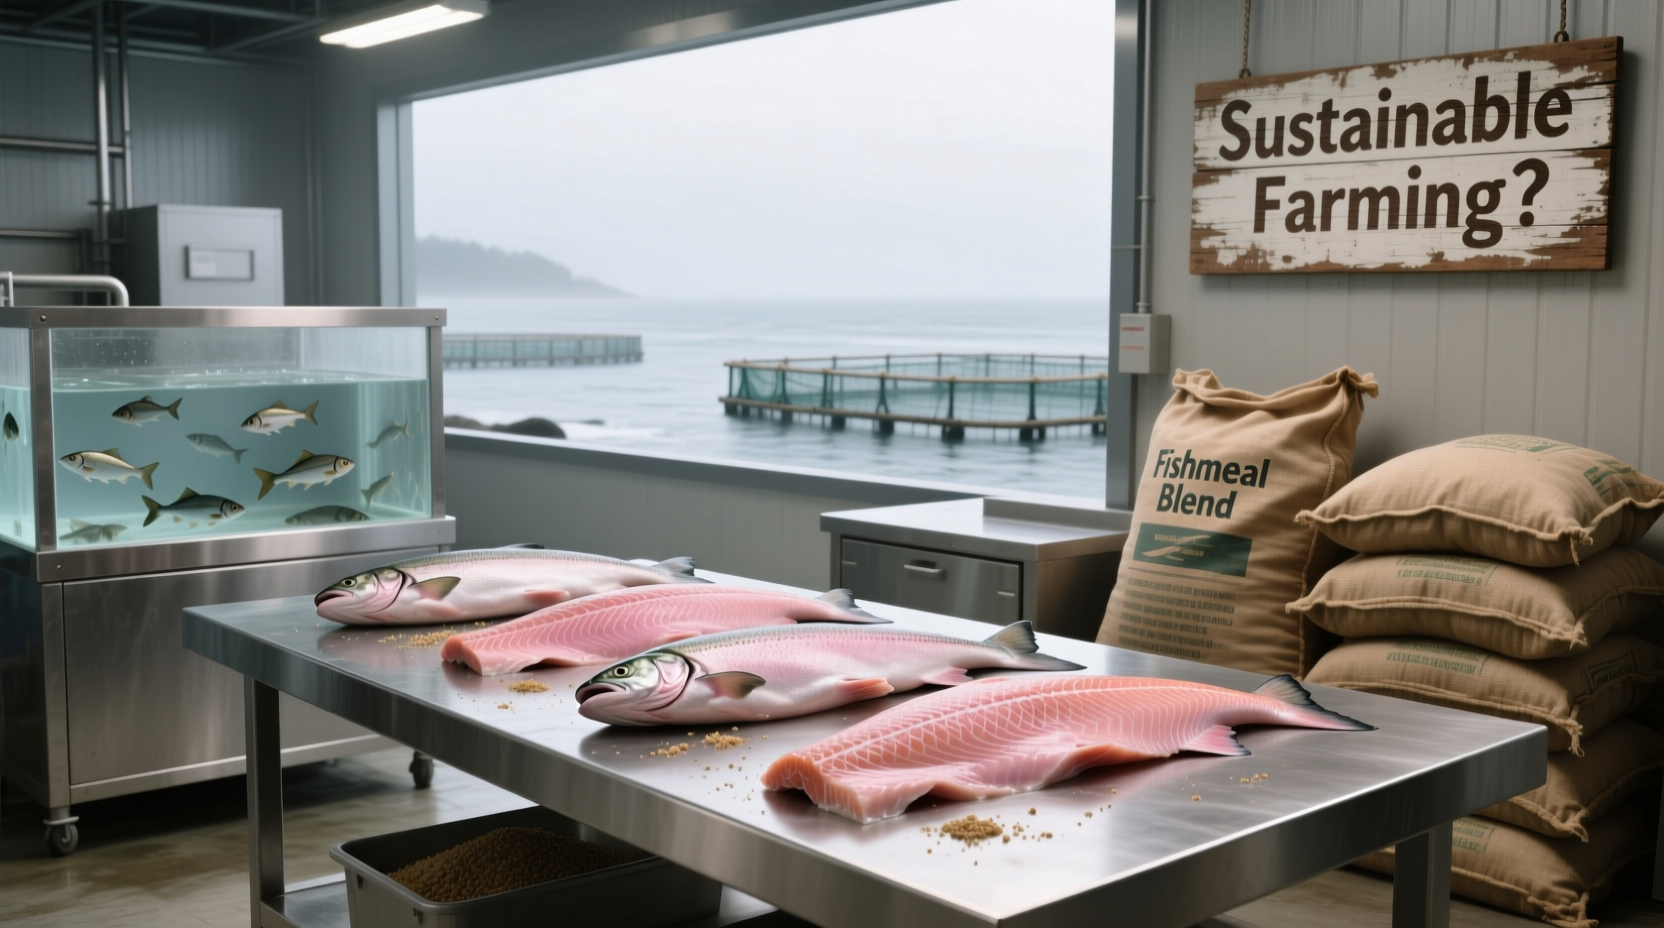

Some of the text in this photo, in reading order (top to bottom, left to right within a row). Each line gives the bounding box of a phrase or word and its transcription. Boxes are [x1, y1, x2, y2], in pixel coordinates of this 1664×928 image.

[1219, 70, 1573, 162] Sustainable
[1253, 158, 1550, 249] Farming?
[1153, 449, 1271, 488] Fishmeal
[1156, 483, 1237, 519] Blend
